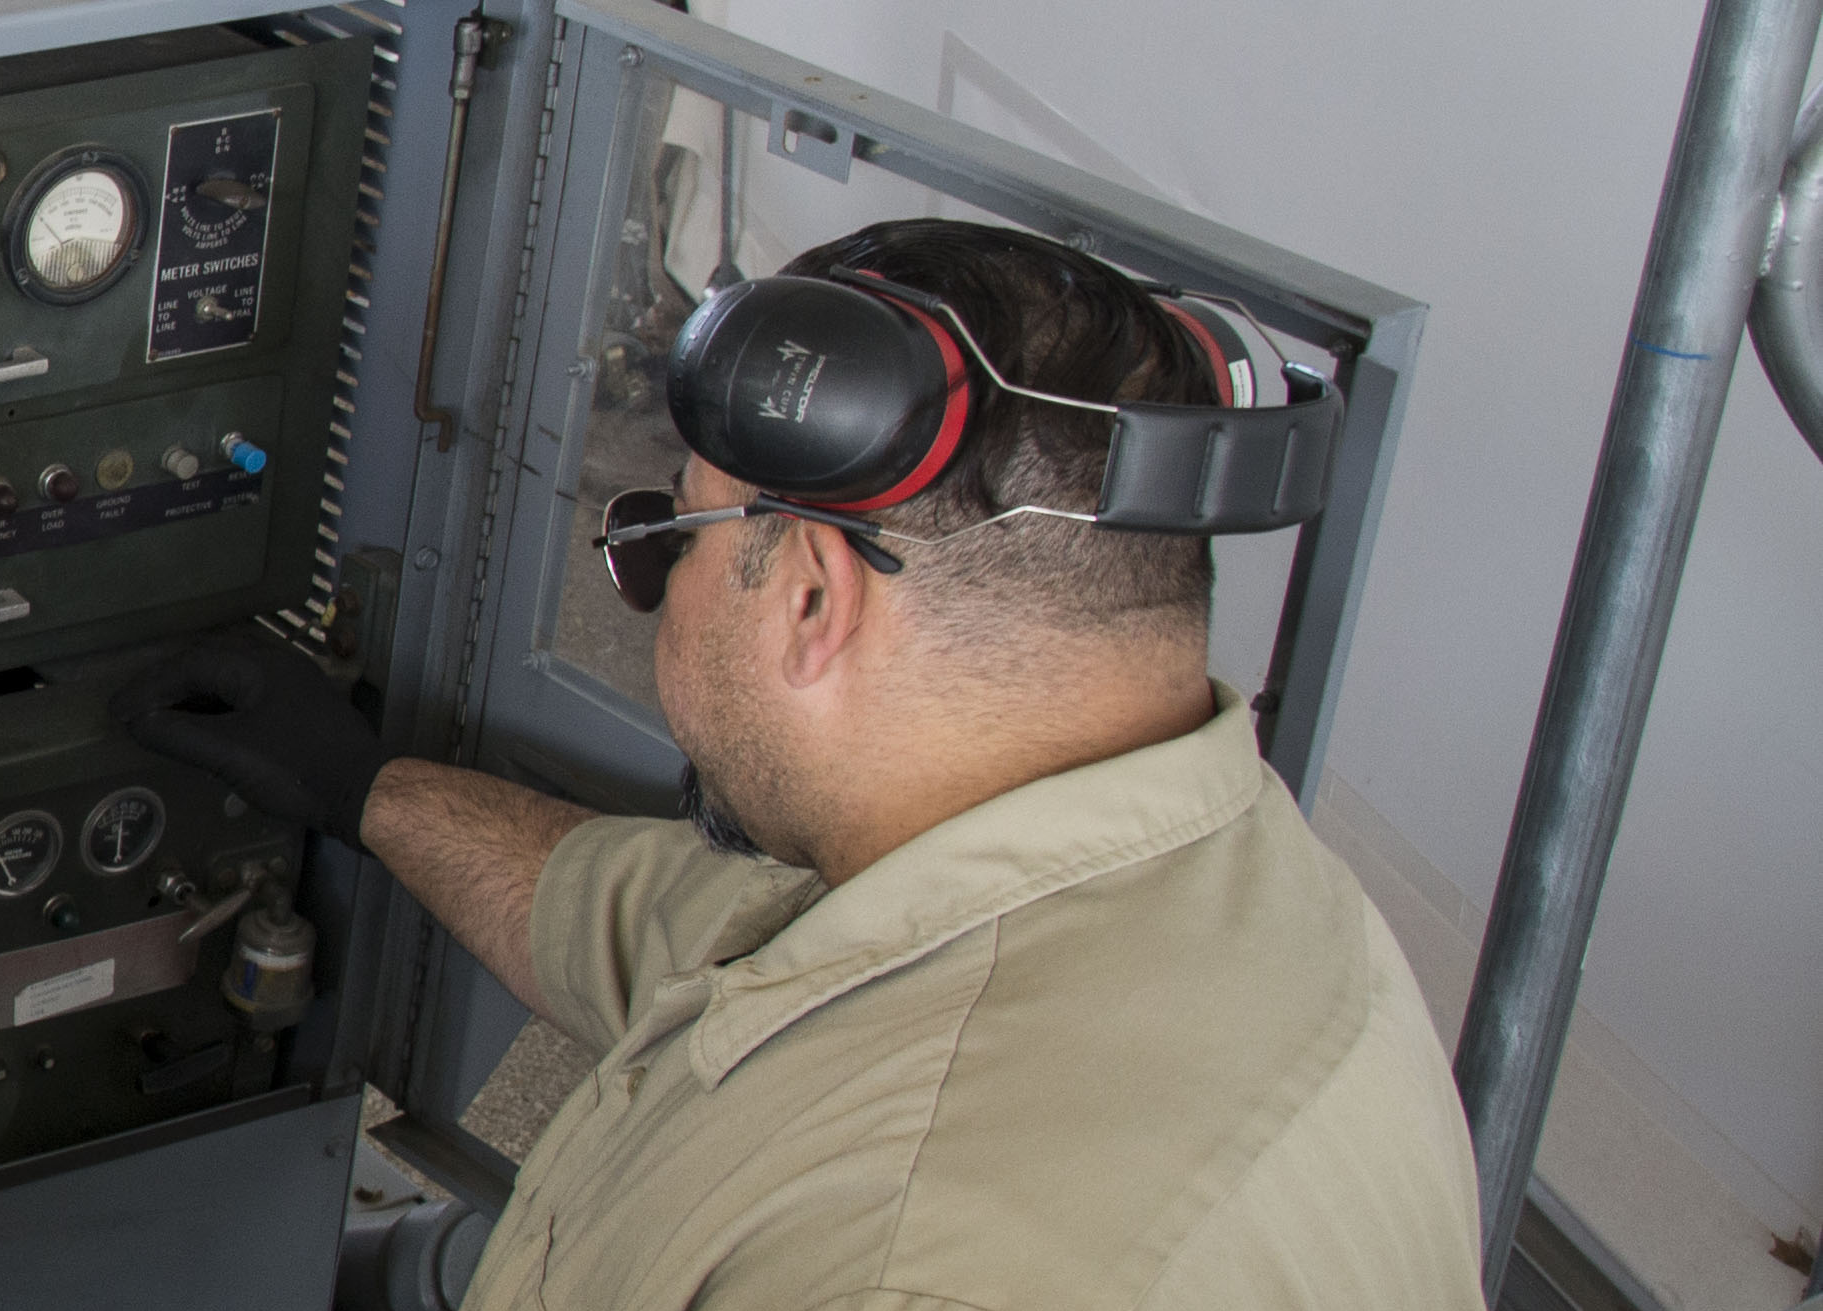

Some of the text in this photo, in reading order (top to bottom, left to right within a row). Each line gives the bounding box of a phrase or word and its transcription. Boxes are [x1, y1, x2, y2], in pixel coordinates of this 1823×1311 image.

[161, 253, 259, 282] METER SWITCHES
[187, 284, 228, 300] VOLTAGE
[234, 285, 255, 298] LINE
[158, 299, 178, 312] LINE
[158, 311, 170, 322] TO
[156, 320, 176, 333] LINE
[95, 494, 131, 511] GROUND
[165, 500, 212, 517] PROTECTIVE
[100, 507, 126, 521] FAULT
[41, 519, 65, 533] LOAD
